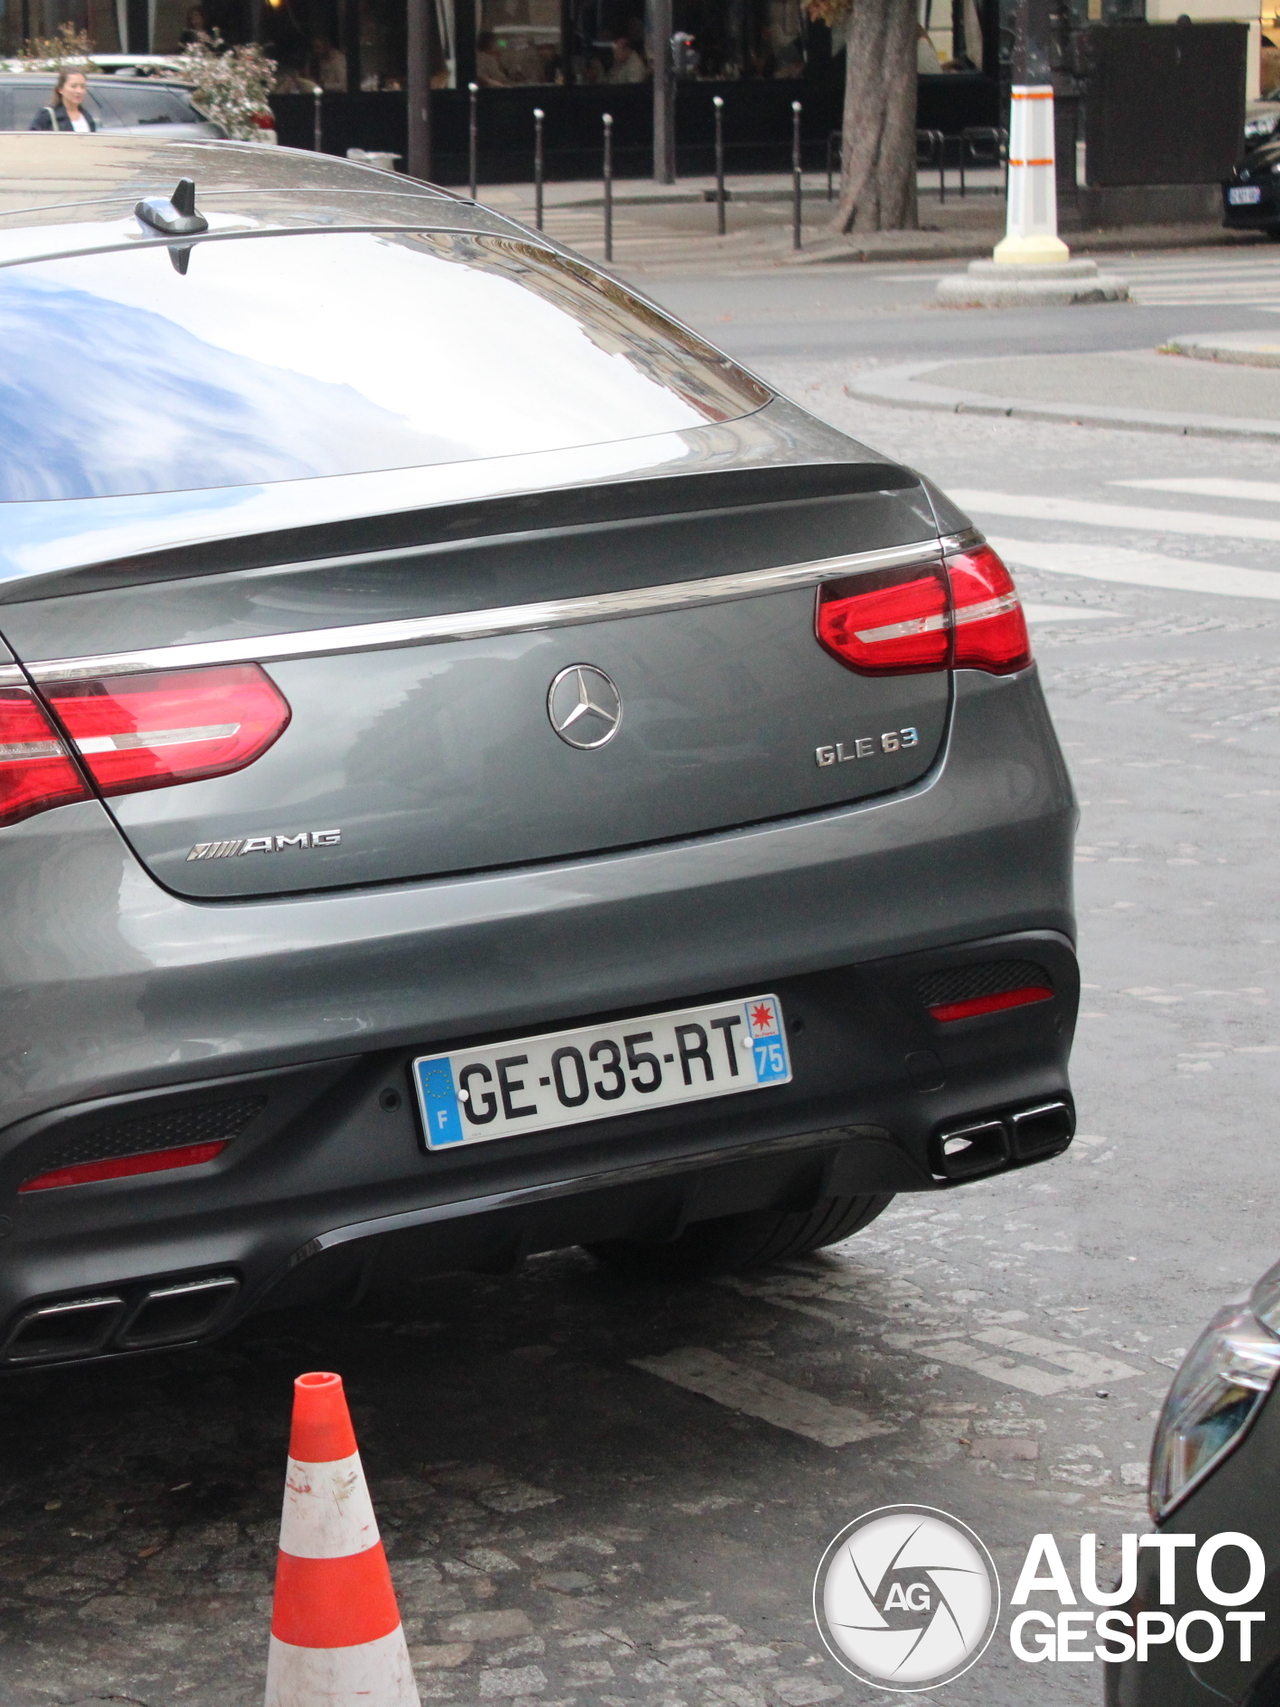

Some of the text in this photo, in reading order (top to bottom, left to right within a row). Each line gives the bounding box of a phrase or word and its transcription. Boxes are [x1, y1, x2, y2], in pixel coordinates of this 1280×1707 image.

[815, 727, 919, 767] GLE 63
[237, 829, 342, 857] AMG
[458, 1014, 742, 1125] GE-035-RT
[755, 1043, 784, 1075] 75
[437, 1110, 448, 1129] F
